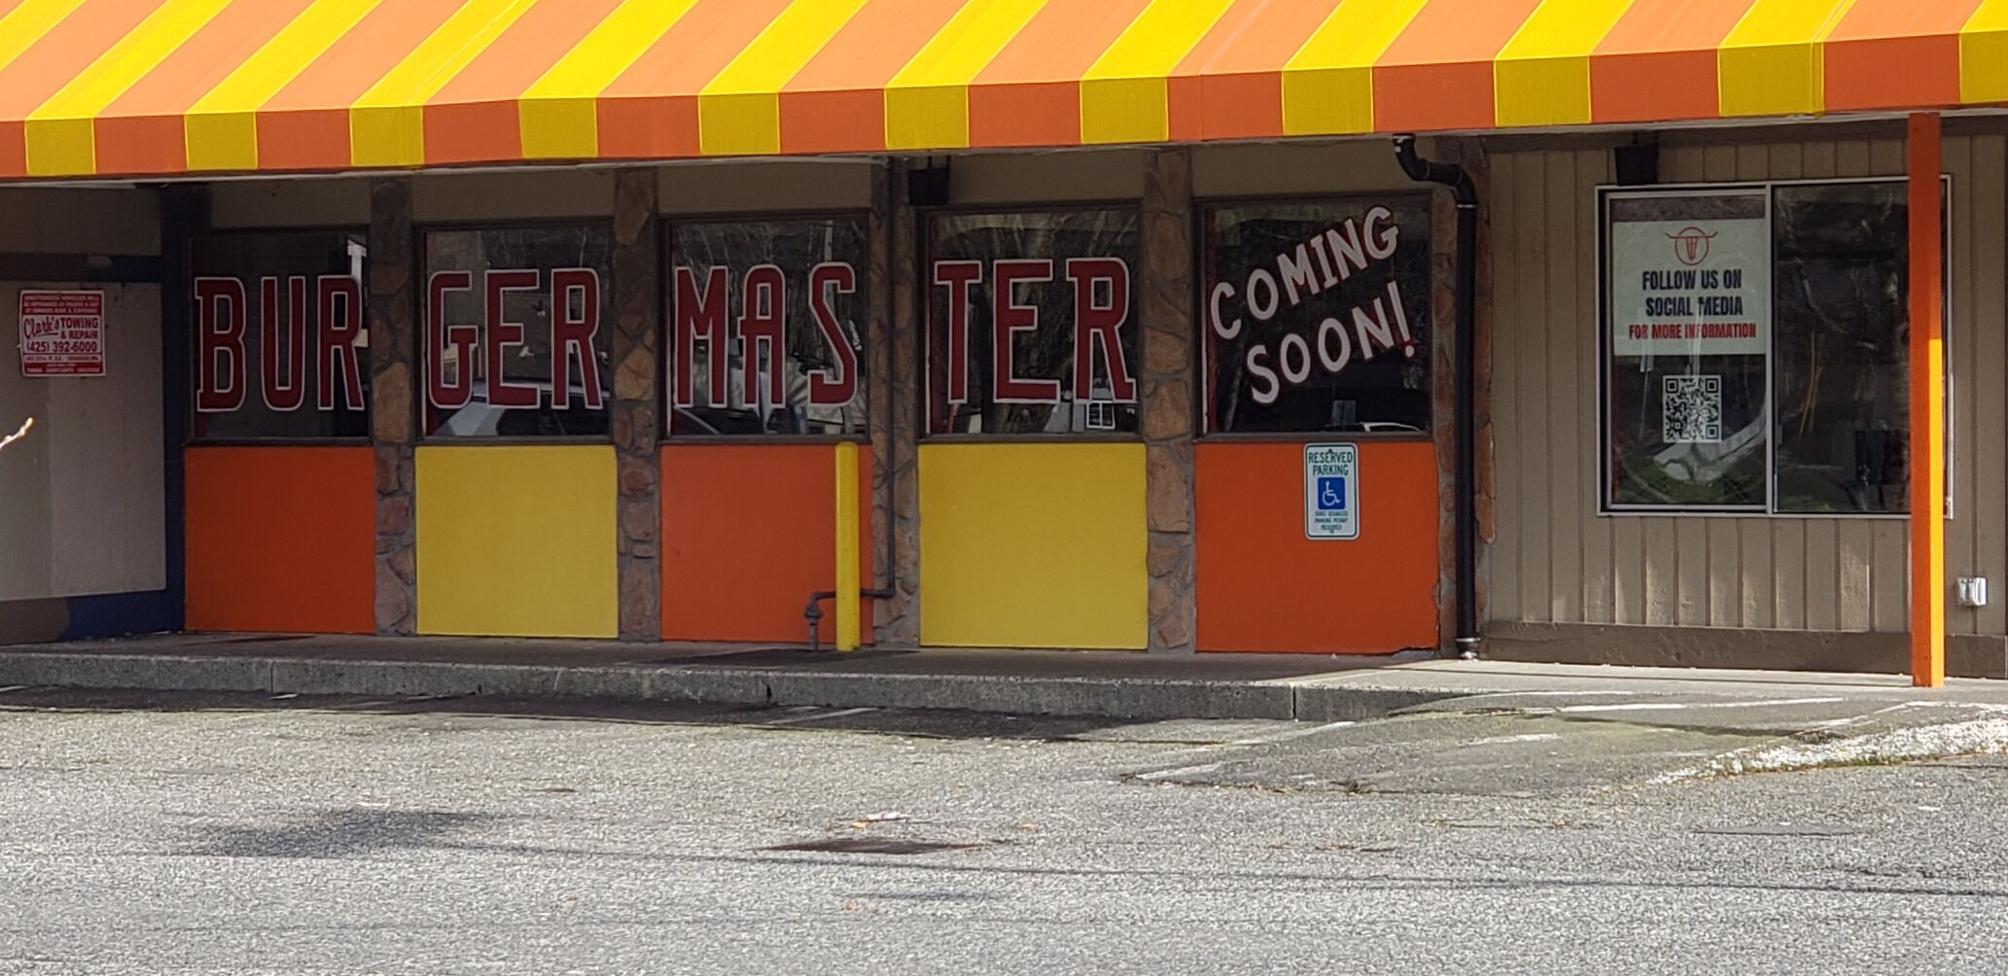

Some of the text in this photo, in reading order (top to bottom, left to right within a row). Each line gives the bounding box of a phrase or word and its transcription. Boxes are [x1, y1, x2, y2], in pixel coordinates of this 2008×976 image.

[1210, 205, 1400, 340] COMING
[1642, 269, 1742, 291] FOLLOW US ON
[1645, 296, 1743, 317] SOCIAL MEDIA
[23, 316, 99, 340] Clark's TOWING
[60, 330, 99, 340] & REPAIR
[1628, 322, 1757, 340] FOR MORE INFORMATION
[26, 340, 98, 353] (425) 392-6000
[1246, 279, 1415, 404] SOON!
[1308, 451, 1353, 464] RESERVED
[1312, 464, 1349, 477] PARKING
